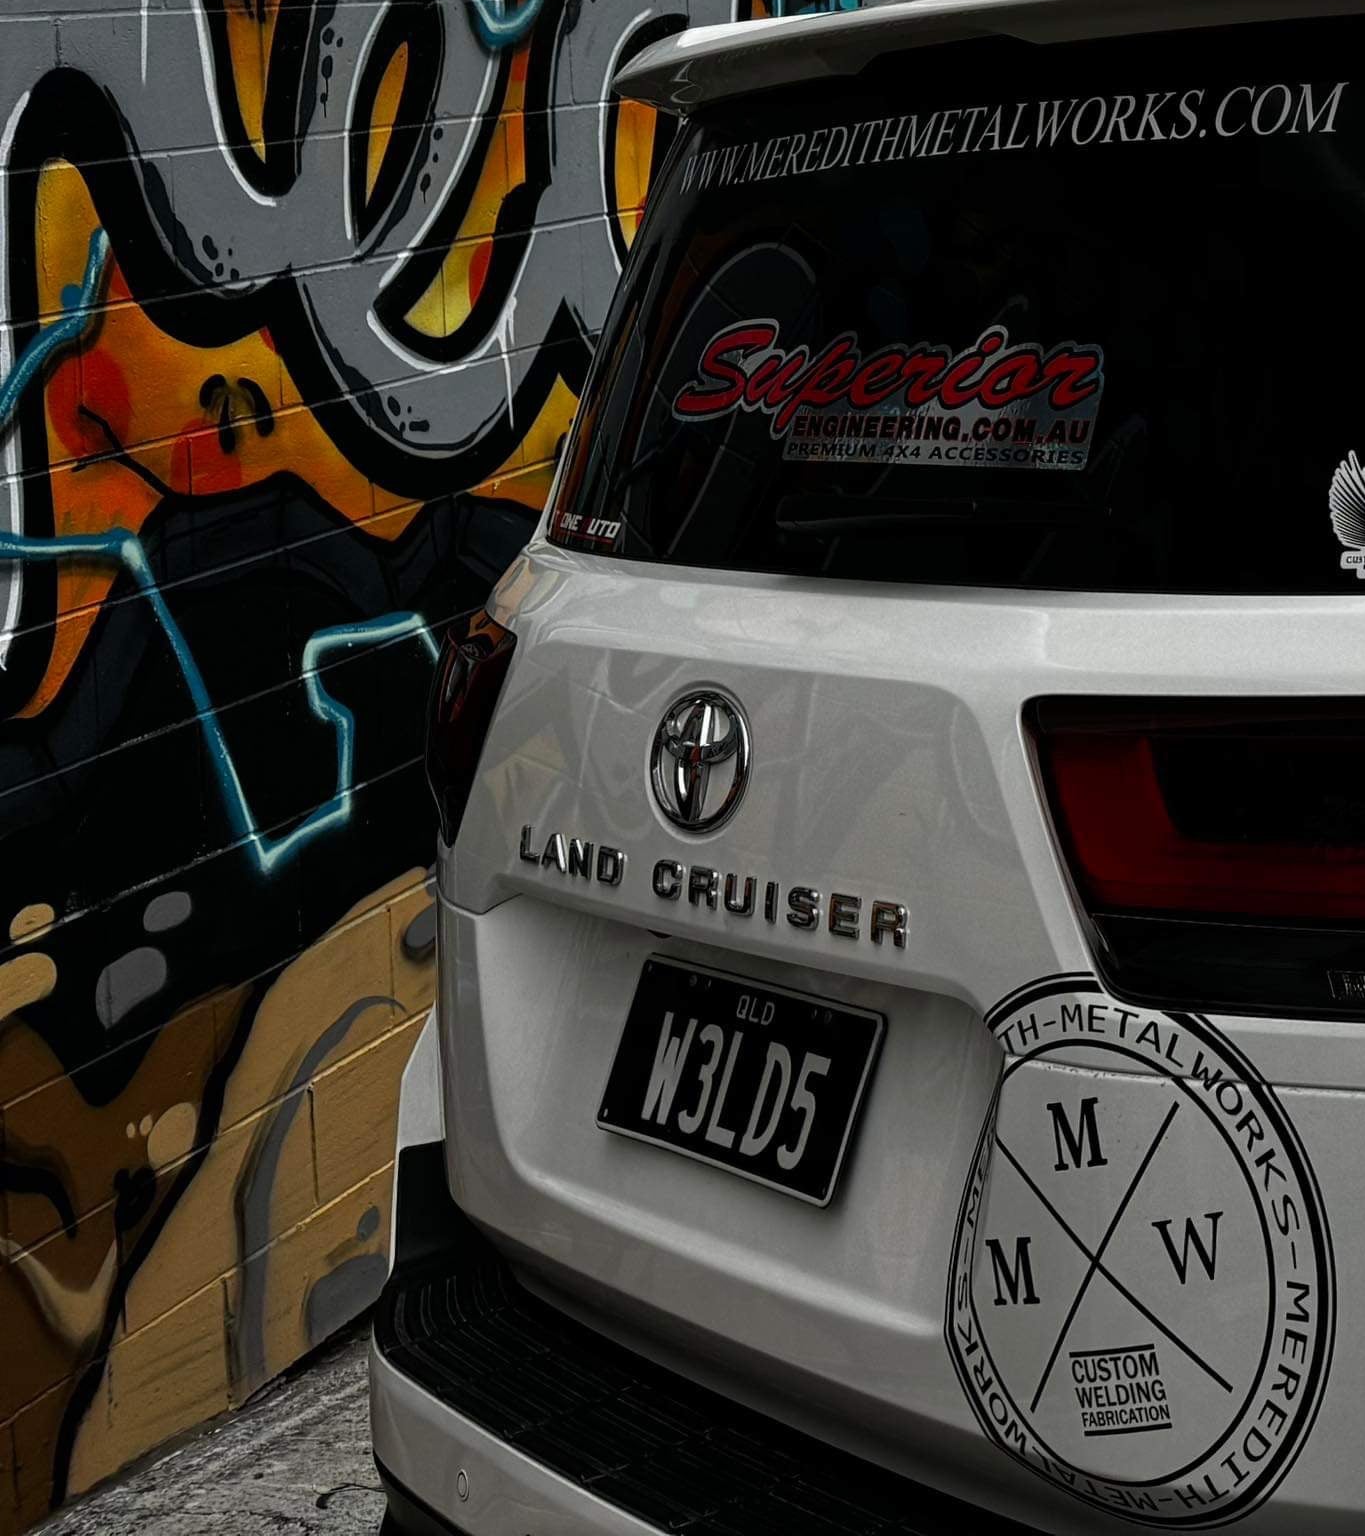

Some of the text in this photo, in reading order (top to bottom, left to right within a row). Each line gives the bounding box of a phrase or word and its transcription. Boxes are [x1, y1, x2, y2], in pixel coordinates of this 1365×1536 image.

[680, 82, 1349, 195] WWW.MEREDITHMETALWORKS.COM
[675, 326, 1100, 434] Superior
[786, 442, 878, 458] PREMIUM
[928, 445, 1085, 466] ACCESSORIES
[792, 414, 1090, 444] ENGINEERING.COM.AU
[519, 823, 911, 949] LAND CRUISER
[735, 994, 775, 1026] QLD
[641, 1010, 832, 1170] W3LD5
[1046, 1096, 1108, 1172] M
[985, 1235, 1041, 1306] M
[1151, 1210, 1224, 1285] W
[1070, 1351, 1161, 1384] CUSTOM
[1075, 1379, 1168, 1409] WELDING
[1081, 1403, 1172, 1429] FABRICATION
